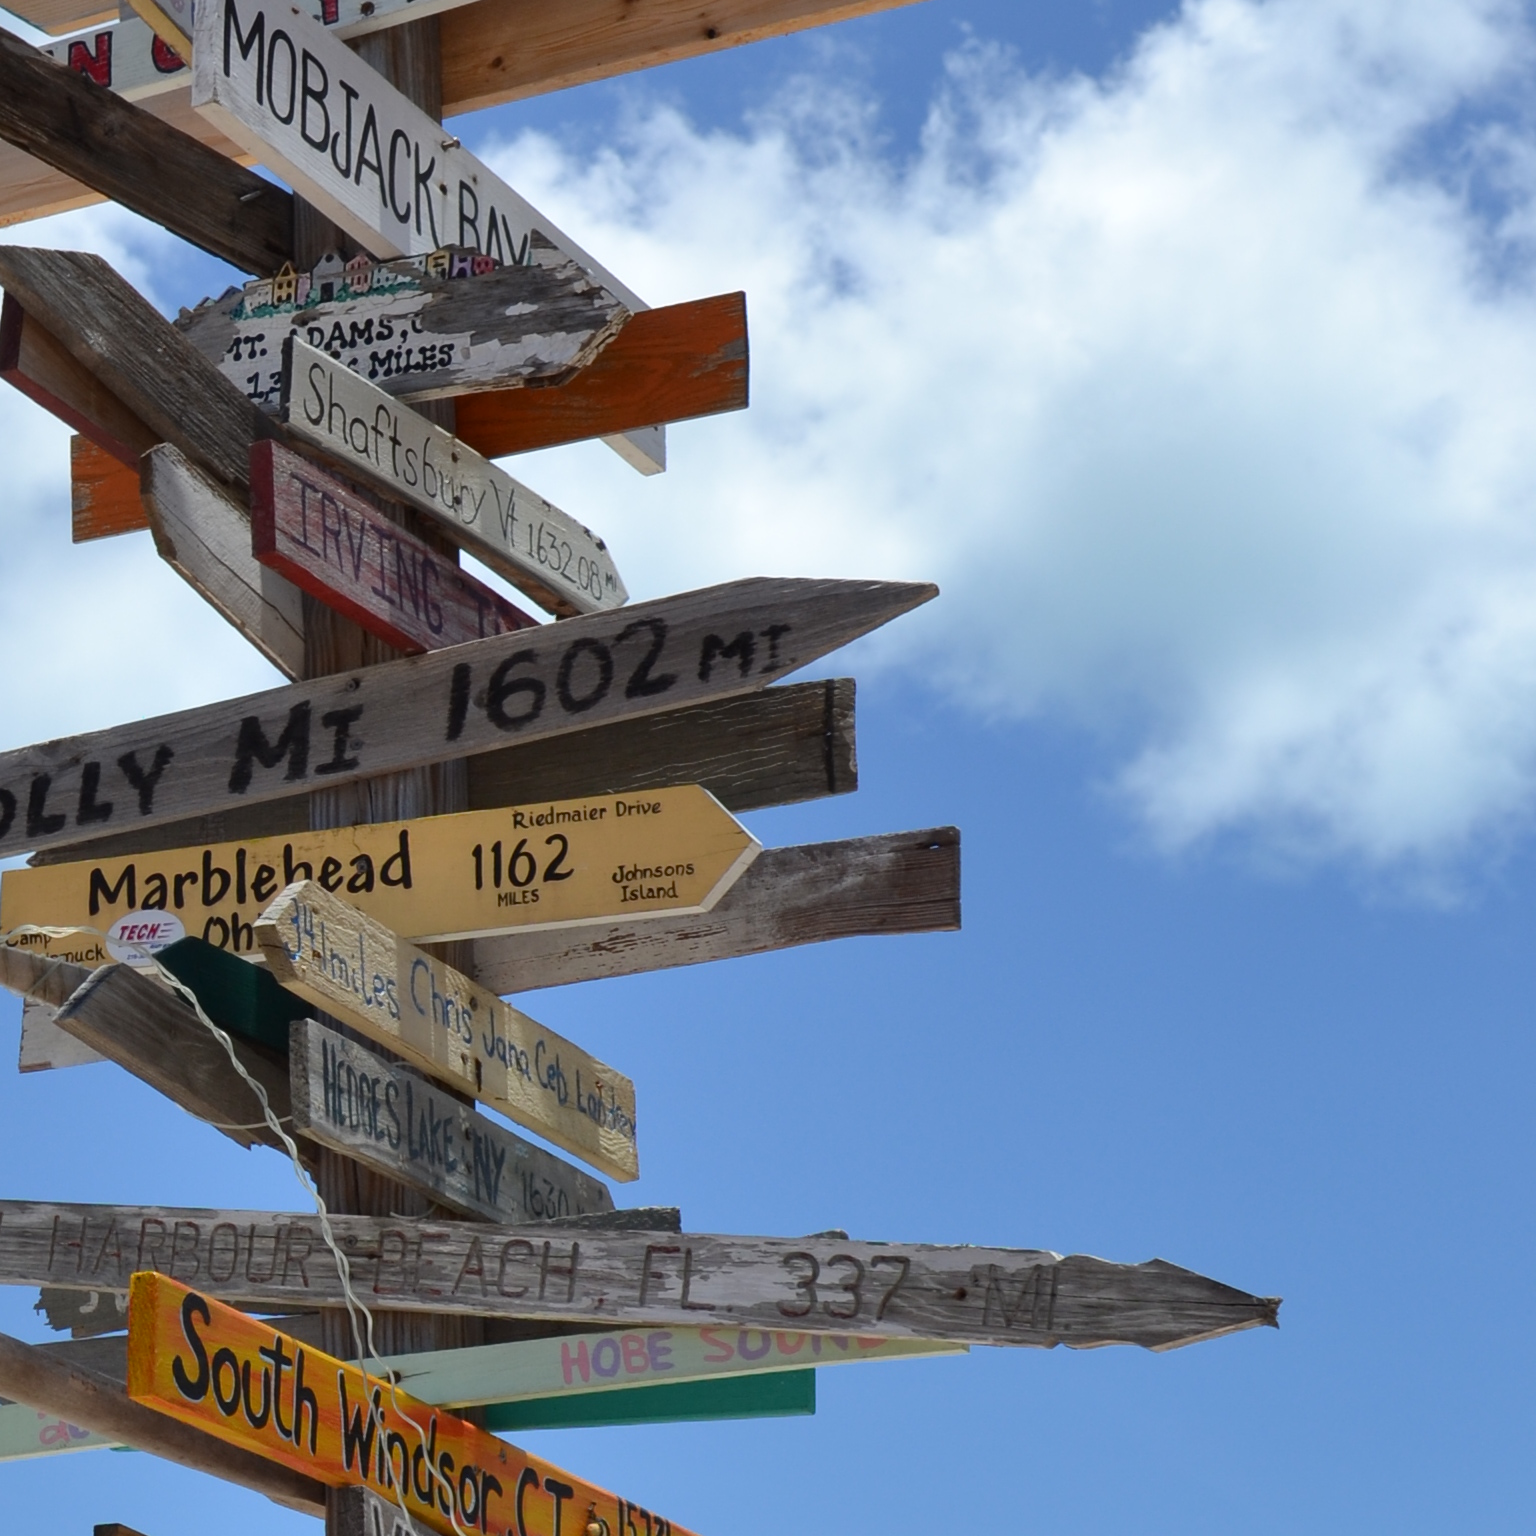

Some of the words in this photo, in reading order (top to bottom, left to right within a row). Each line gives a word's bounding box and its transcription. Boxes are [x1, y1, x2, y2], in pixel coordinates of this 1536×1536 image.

[303, 362, 486, 526] Shaftsbury
[289, 470, 443, 635] IRVING
[227, 701, 364, 794] MI
[445, 619, 690, 742] 1602
[512, 804, 608, 830] Riedmaier
[616, 798, 662, 819] Drive
[88, 830, 413, 916] Marblehead
[471, 834, 574, 891] 1162
[497, 888, 540, 907] MILES
[611, 862, 695, 884] Johnsons
[619, 881, 678, 903] Island
[118, 922, 159, 941] TECH
[410, 957, 473, 1045] Chris
[322, 1037, 401, 1150] HEDGES
[407, 1080, 459, 1174] LAKE
[47, 1215, 314, 1290] HARBOUR
[777, 1250, 912, 1323] 337
[172, 1291, 319, 1457] South
[560, 1330, 675, 1385] HOBE
